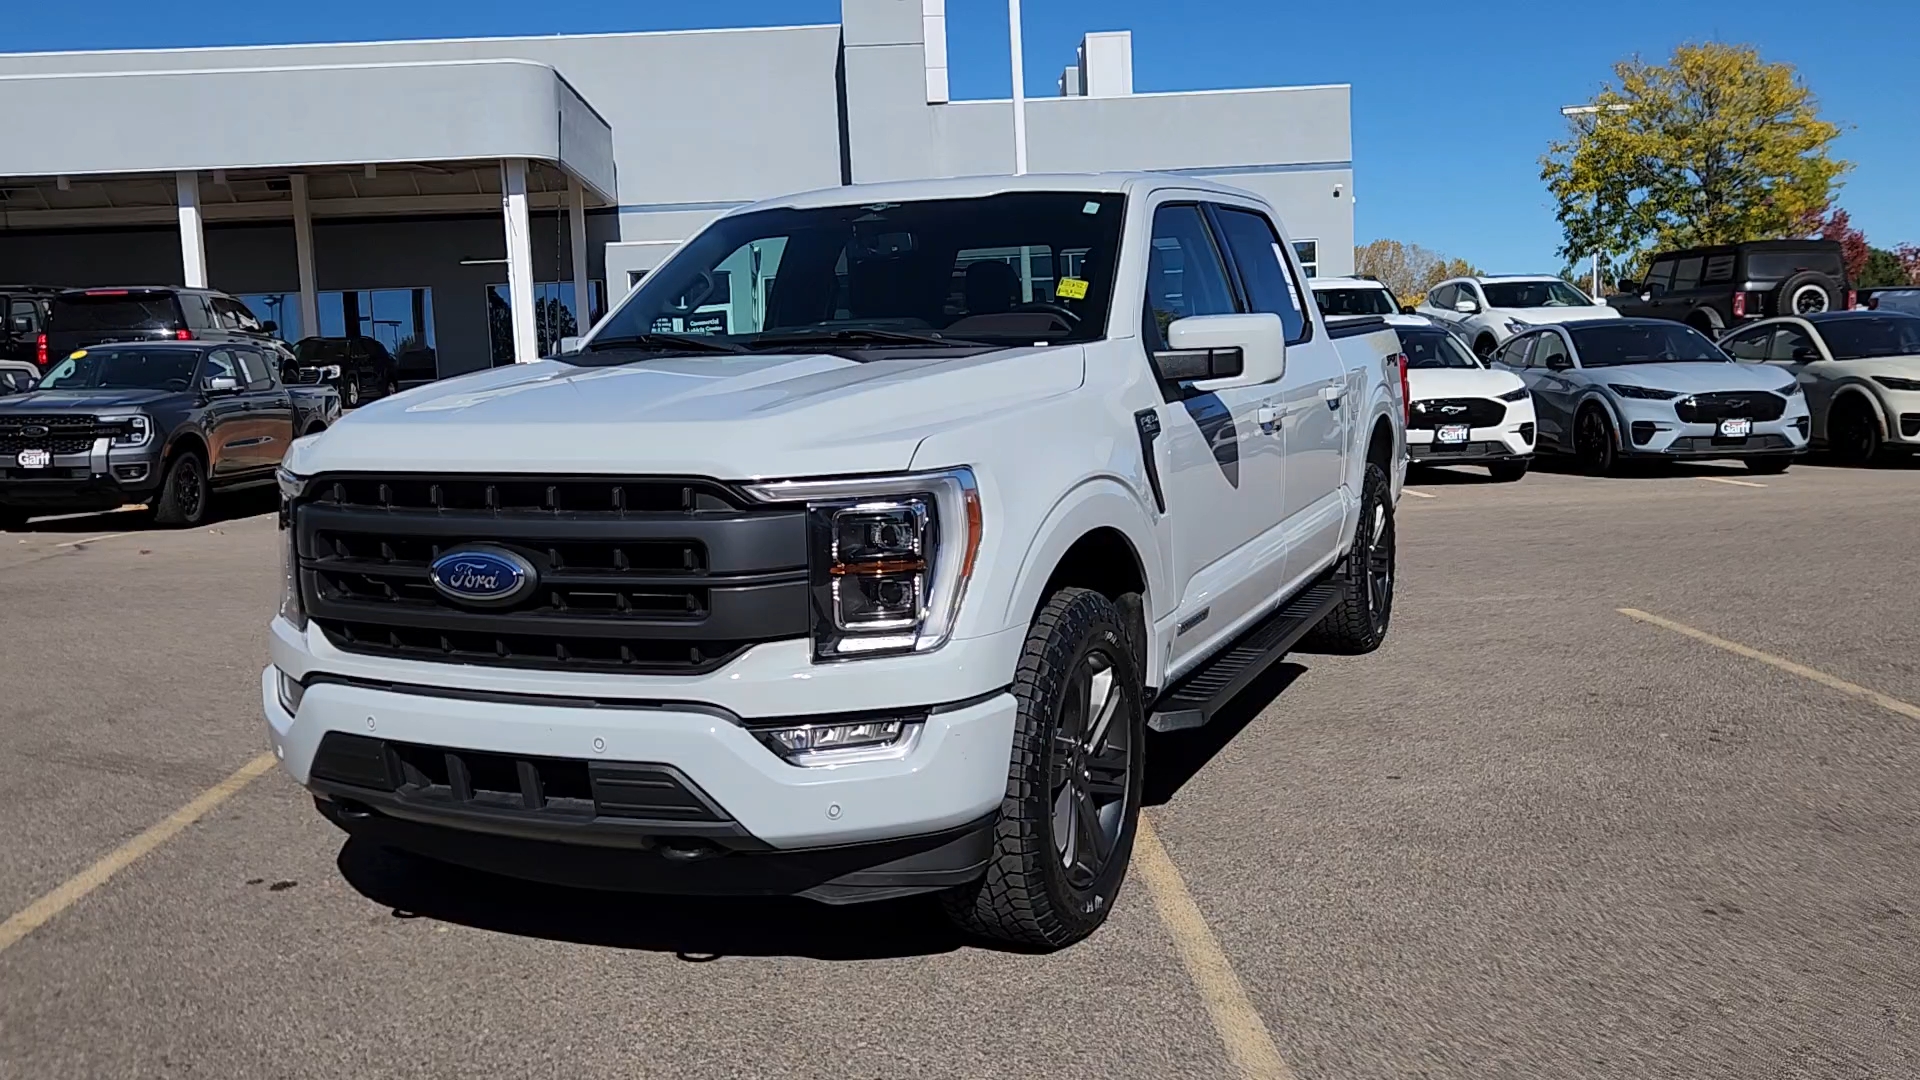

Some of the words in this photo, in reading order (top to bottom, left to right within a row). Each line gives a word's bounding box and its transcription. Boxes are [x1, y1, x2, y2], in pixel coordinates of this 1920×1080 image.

[1437, 427, 1467, 440] Garff
[1720, 420, 1750, 435] Garff
[450, 562, 499, 589] Ford
